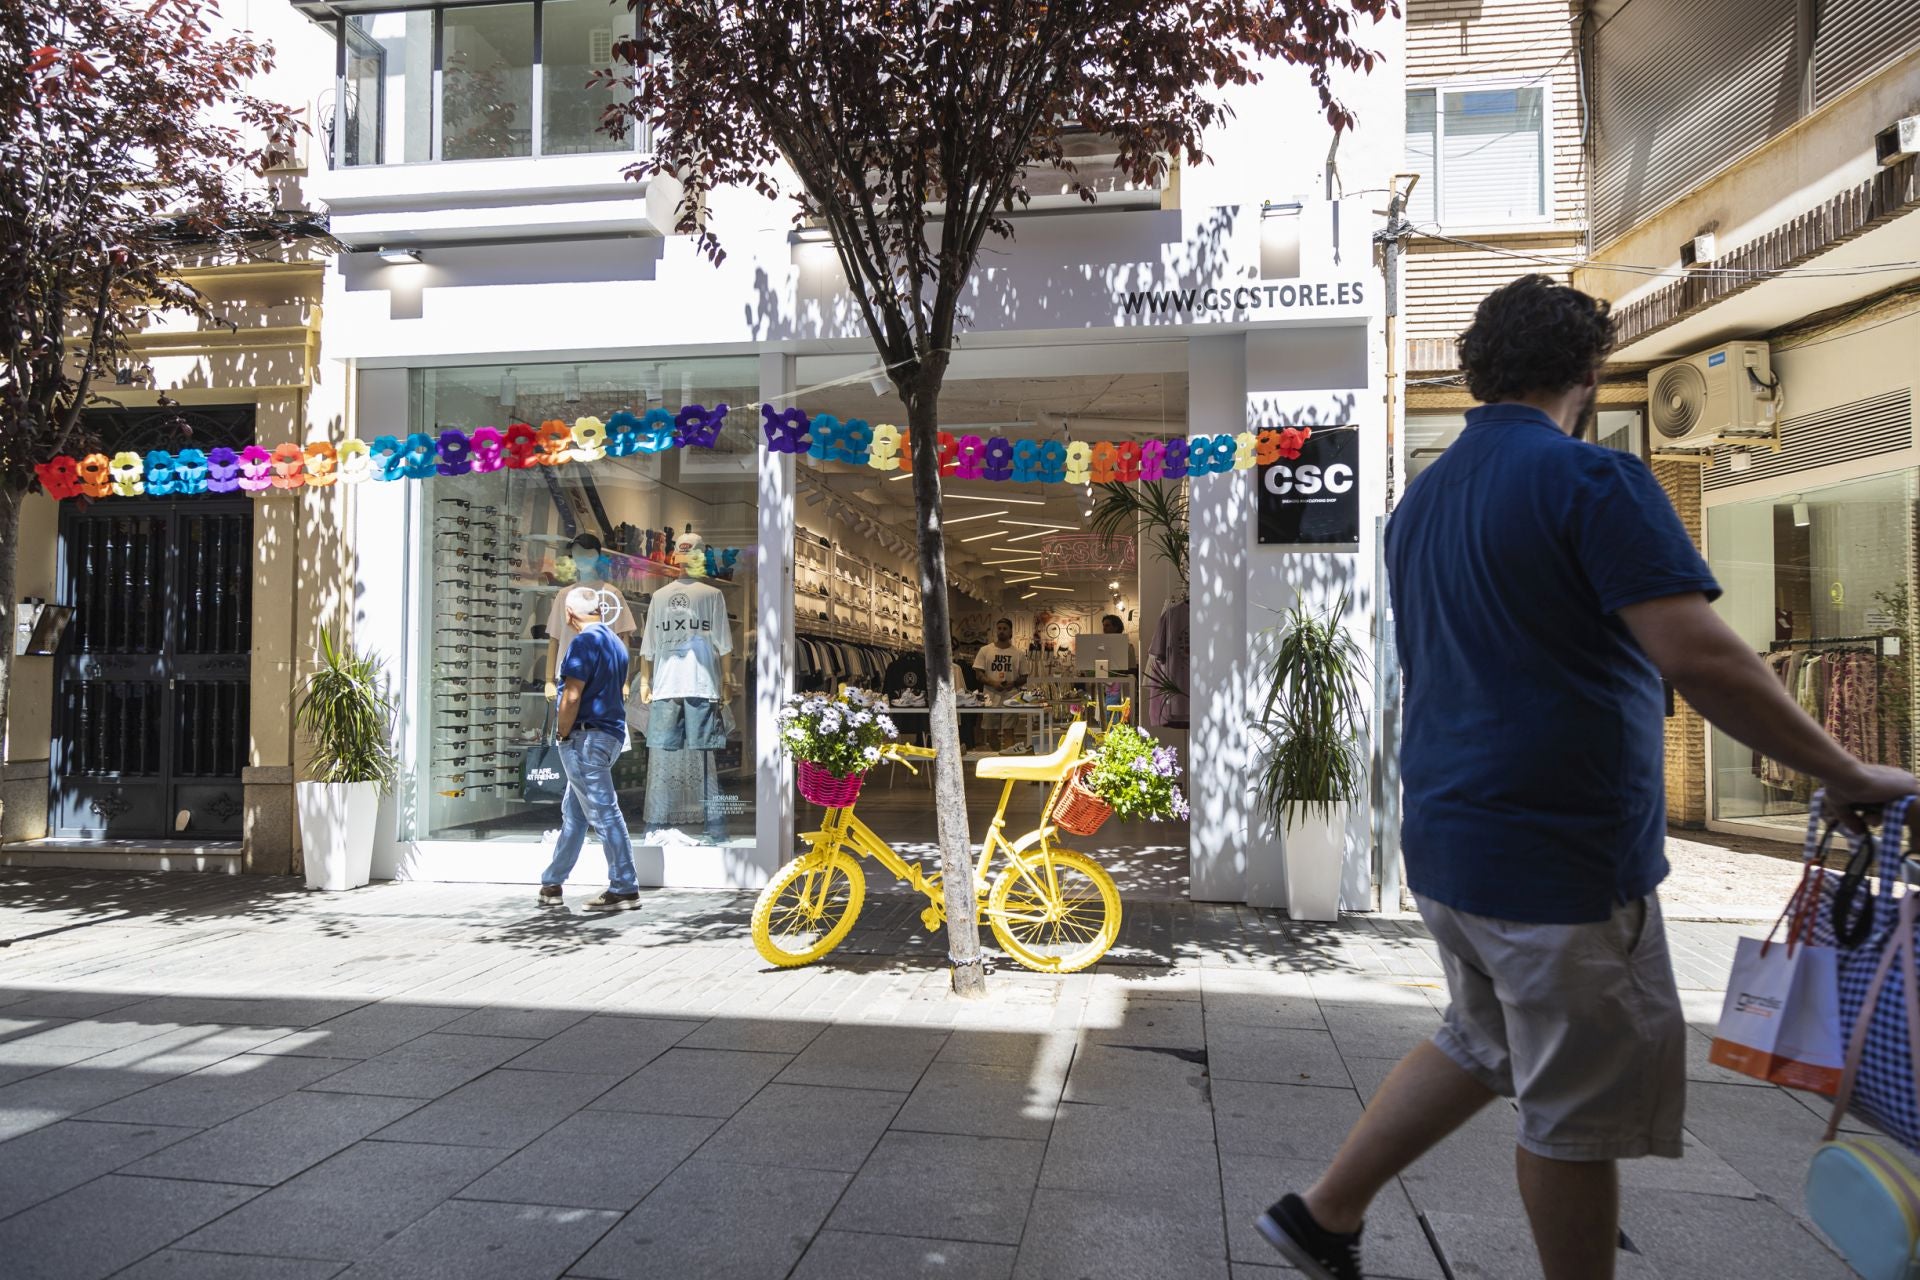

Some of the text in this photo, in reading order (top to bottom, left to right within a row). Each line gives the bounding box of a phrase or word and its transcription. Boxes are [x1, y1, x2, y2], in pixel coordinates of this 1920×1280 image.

[1120, 282, 1364, 314] WWW.CSCSTORE.ES
[1264, 463, 1353, 495] CSC
[991, 662, 1003, 671] DO
[994, 654, 1012, 663] JUST
